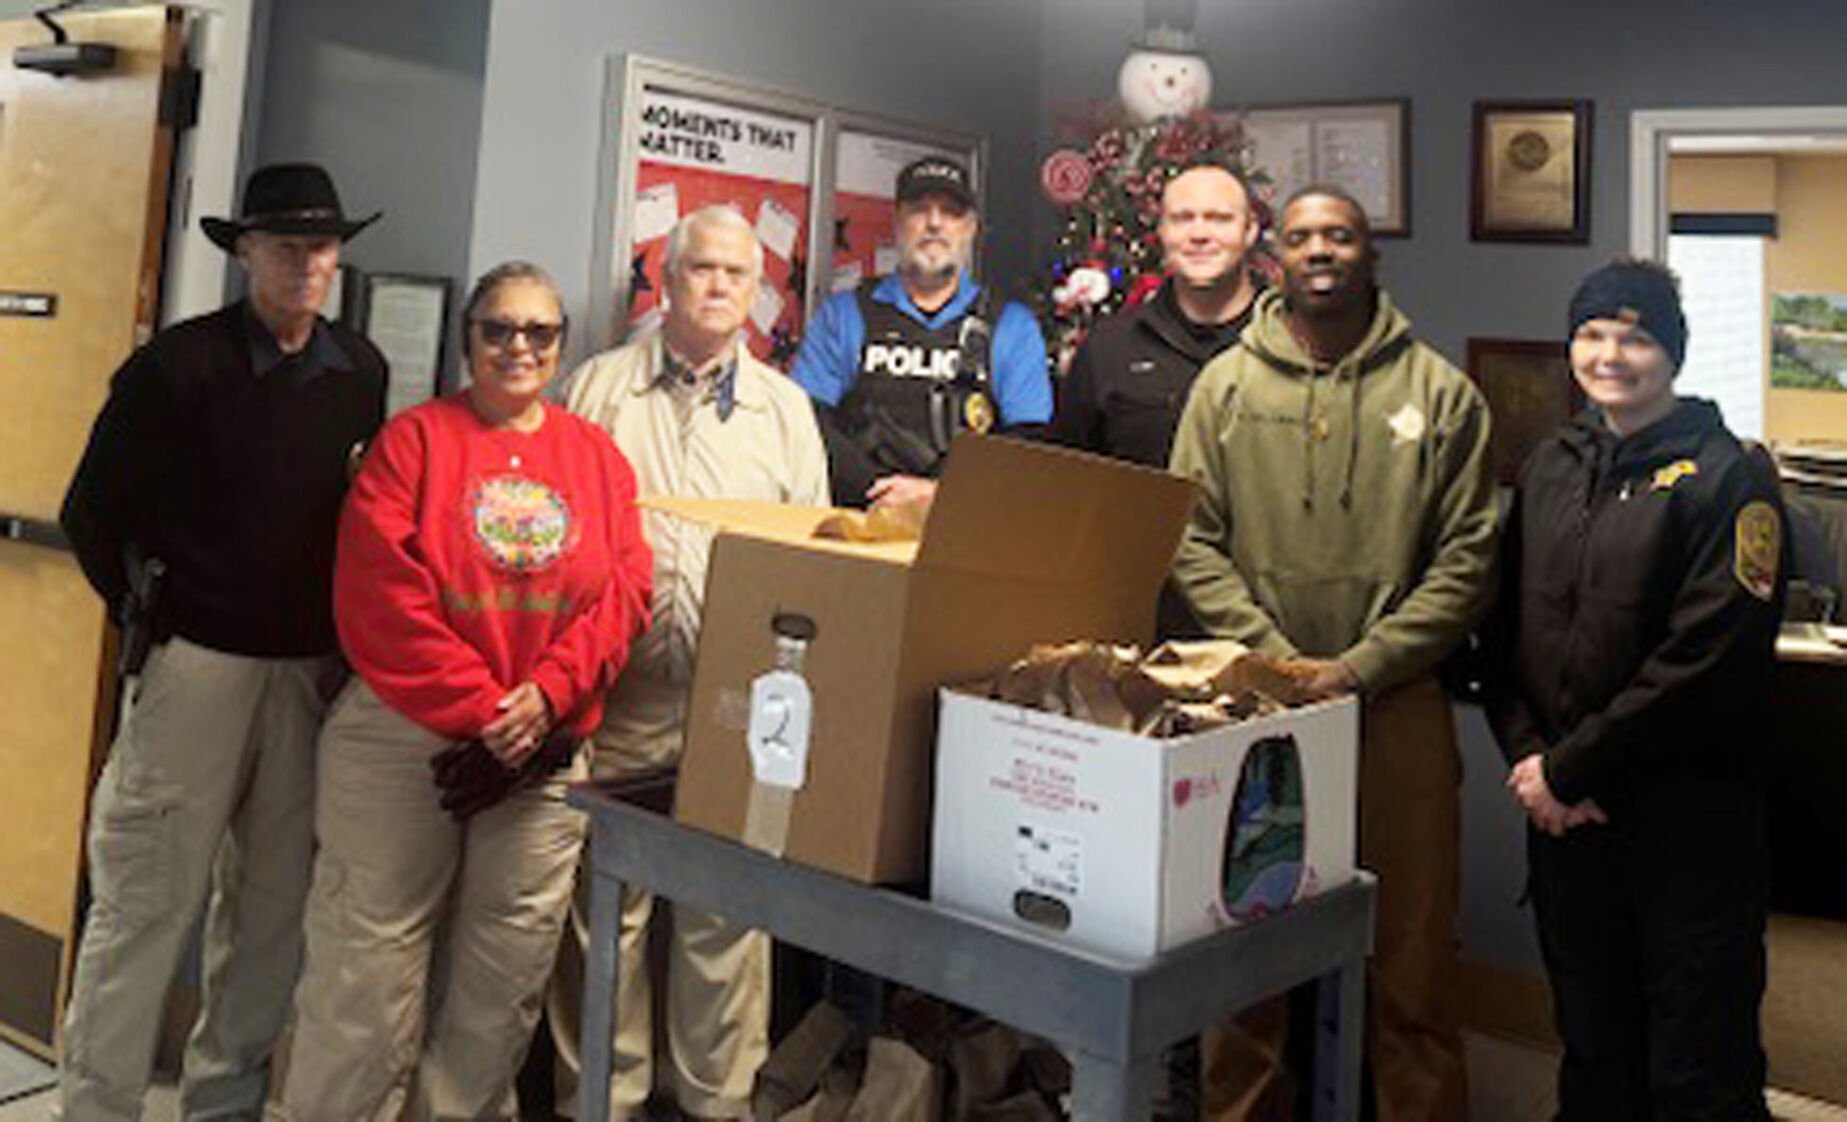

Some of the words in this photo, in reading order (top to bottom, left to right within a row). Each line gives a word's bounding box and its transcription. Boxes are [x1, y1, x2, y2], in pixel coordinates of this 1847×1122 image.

[747, 122, 797, 152] THAT
[864, 343, 984, 380] POLIC
[761, 693, 792, 747] 2
